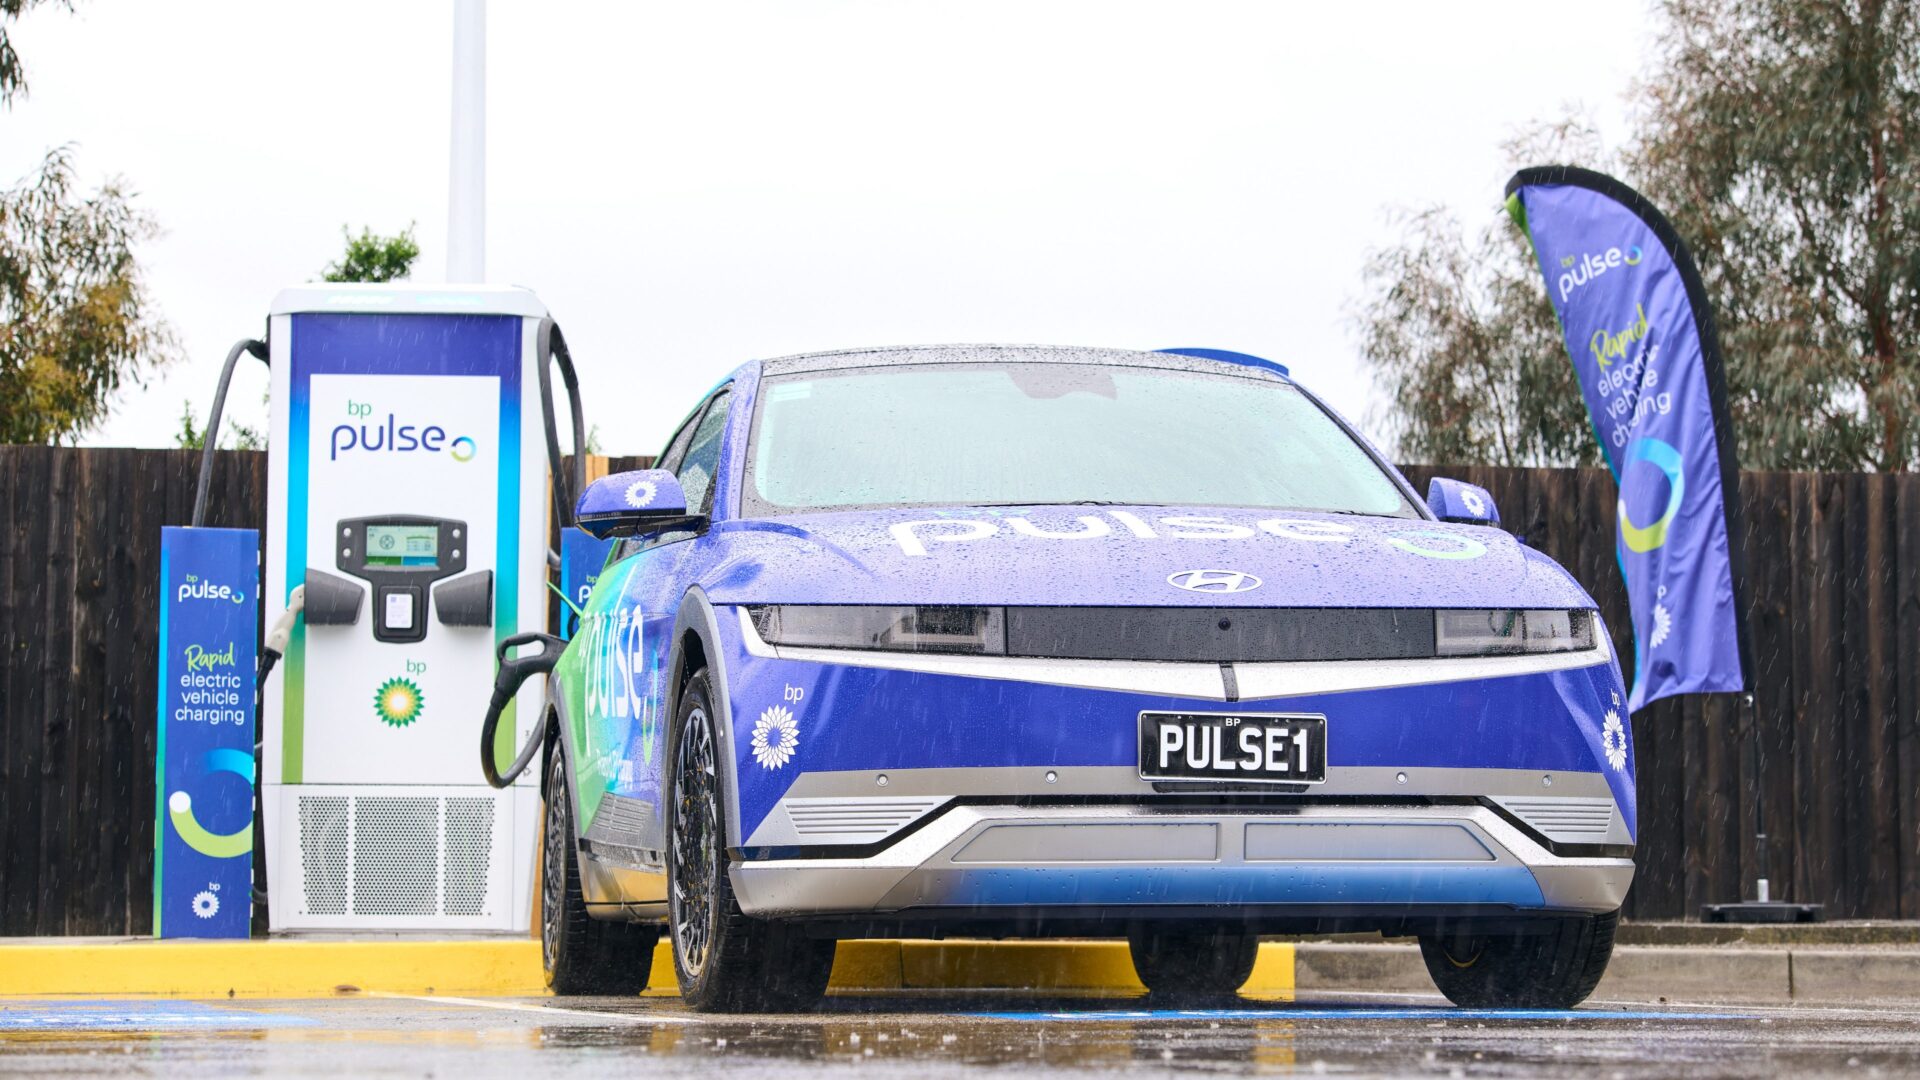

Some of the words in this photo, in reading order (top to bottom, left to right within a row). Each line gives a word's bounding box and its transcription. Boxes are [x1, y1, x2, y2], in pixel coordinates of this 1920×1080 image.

[1558, 246, 1622, 303] pulse
[1590, 303, 1648, 372] Rapid
[1606, 368, 1658, 420] vehle
[348, 399, 373, 419] bp
[1612, 391, 1672, 448] chging
[331, 413, 446, 461] pulse
[888, 510, 1355, 556] pulse
[186, 573, 199, 584] bp
[178, 579, 231, 602] pulse
[184, 641, 235, 672] Rapid
[406, 658, 427, 676] bp
[584, 562, 644, 758] pulse
[180, 671, 241, 688] electric
[181, 688, 240, 705] vehicle
[784, 682, 804, 704] bp
[174, 705, 245, 726] charging
[1225, 717, 1241, 727] BP
[1159, 724, 1308, 773] PULSE1
[208, 881, 221, 892] bp
